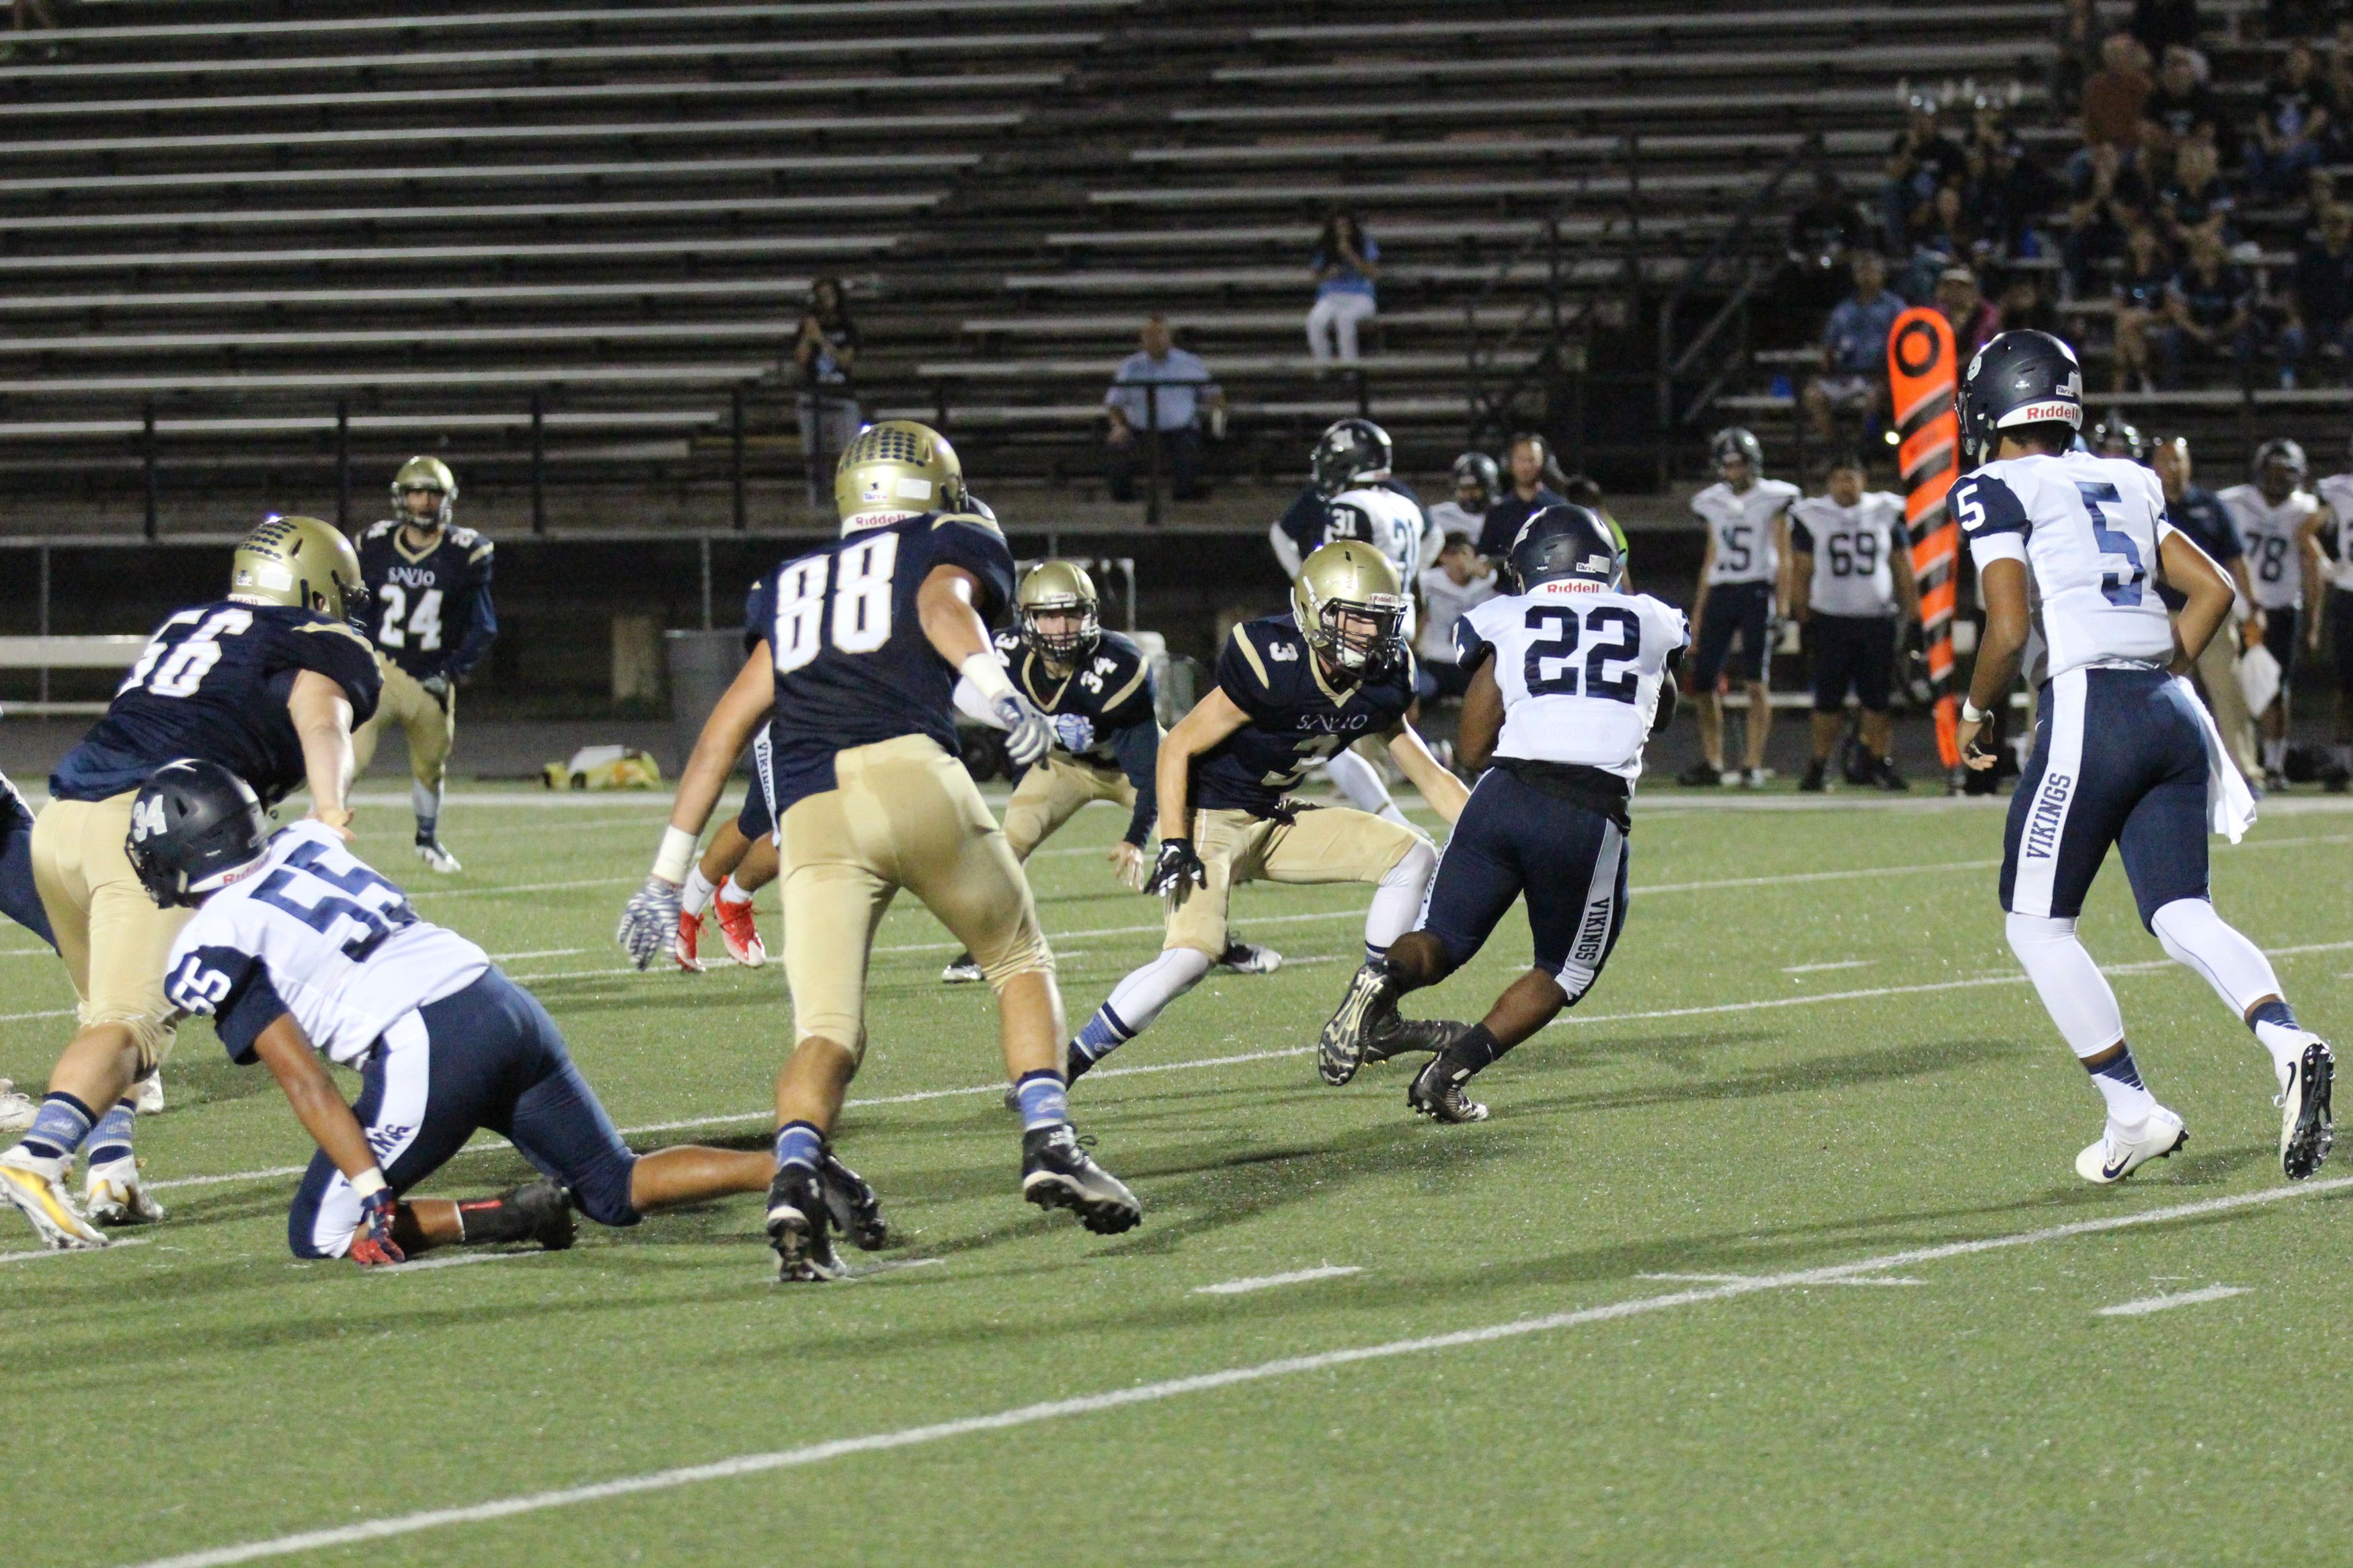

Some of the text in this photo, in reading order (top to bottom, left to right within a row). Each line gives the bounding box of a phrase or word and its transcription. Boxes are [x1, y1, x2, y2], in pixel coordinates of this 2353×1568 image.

[2027, 406, 2079, 420] Riddell
[856, 513, 906, 526] Riddell
[1331, 508, 1357, 538] 31
[1956, 483, 1986, 532] 5
[1829, 532, 1876, 576] 69
[2075, 481, 2146, 606] 5
[2245, 531, 2286, 582] 78
[775, 532, 900, 674] 88
[1548, 583, 1599, 593] Riddell
[378, 583, 444, 651] 24
[1080, 655, 1119, 694] 34
[1269, 642, 1299, 661] 3
[1524, 606, 1639, 704] 22
[134, 794, 167, 842] 34
[2026, 773, 2071, 858] VIKINGS
[247, 840, 421, 963] 55
[1574, 897, 1610, 960] VIKINGS
[171, 956, 232, 1016] 55
